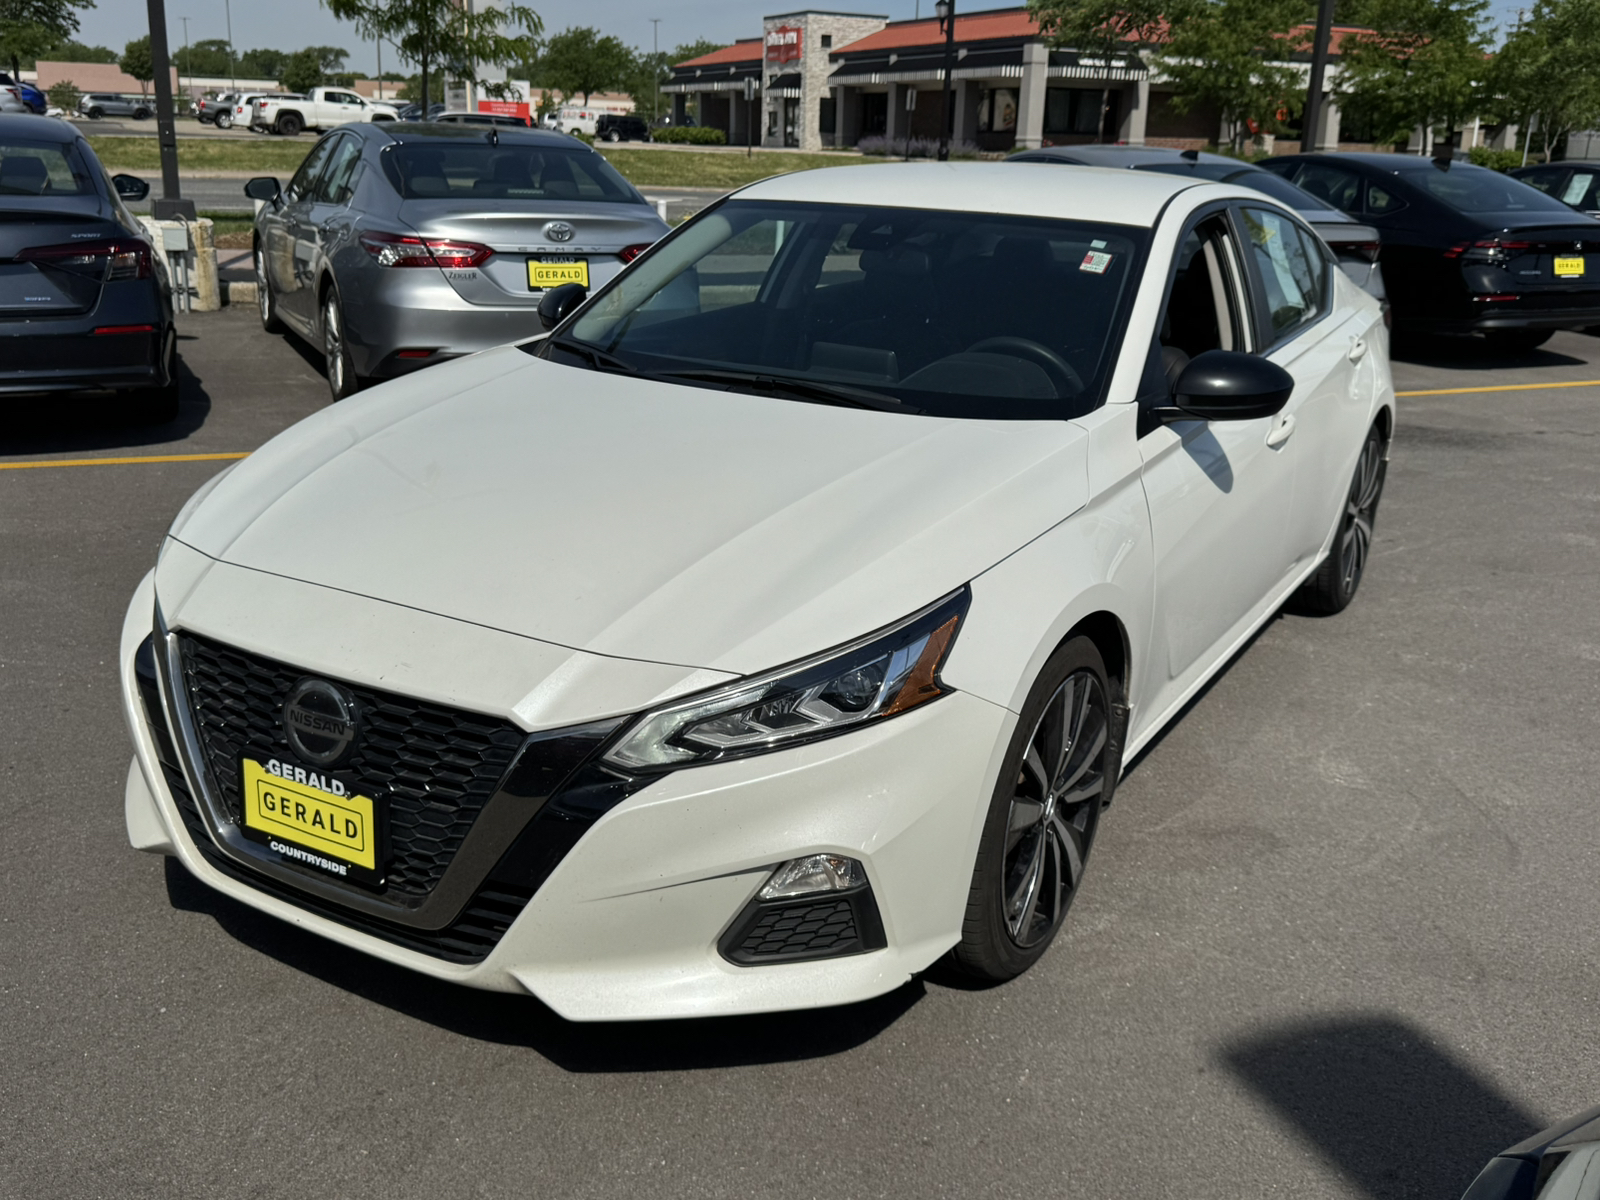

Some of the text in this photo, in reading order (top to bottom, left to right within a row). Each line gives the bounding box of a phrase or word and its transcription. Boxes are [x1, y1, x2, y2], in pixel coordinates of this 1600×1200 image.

[537, 270, 581, 279] GERALD
[289, 709, 345, 736] NISSAN
[268, 758, 345, 797] GERALD
[263, 791, 359, 839] GERALD
[269, 840, 348, 876] COUNTRYSIDE
